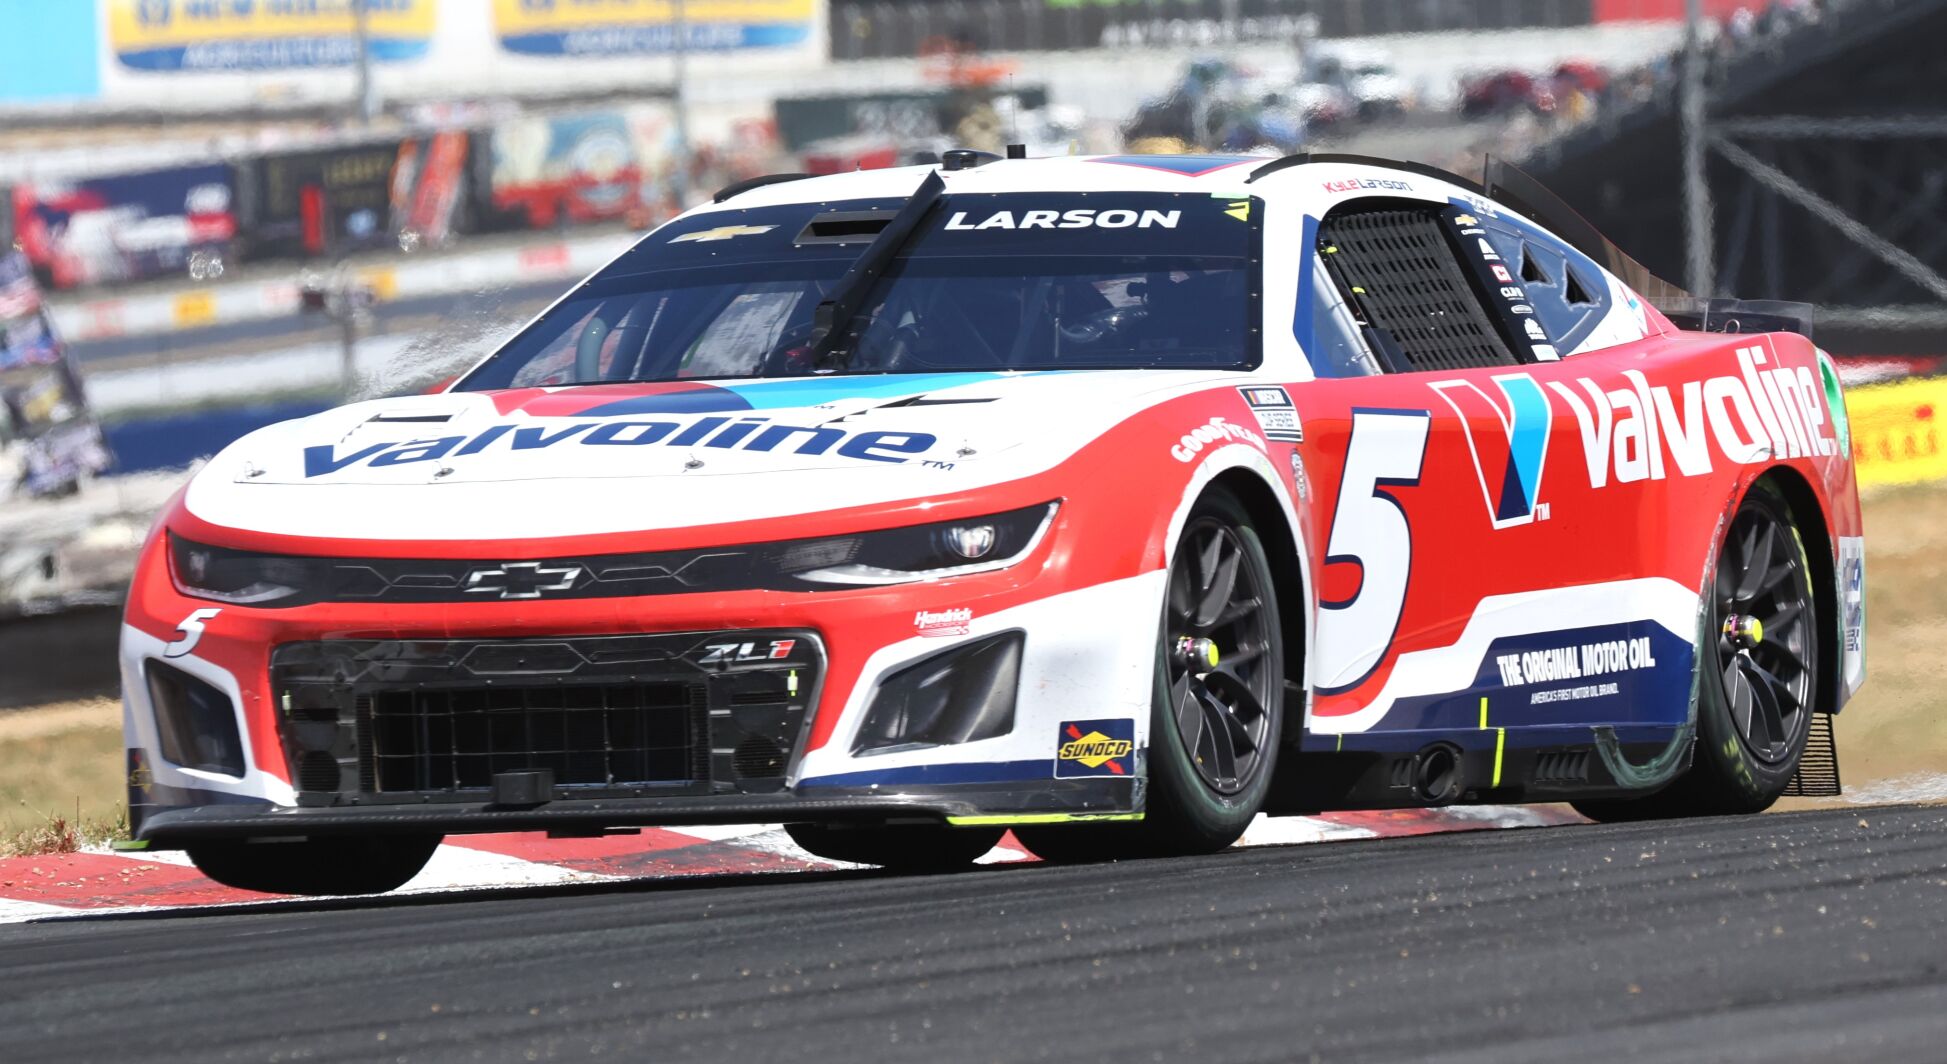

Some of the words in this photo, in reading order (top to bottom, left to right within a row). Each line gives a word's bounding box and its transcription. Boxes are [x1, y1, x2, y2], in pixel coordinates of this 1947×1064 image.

[943, 208, 1182, 231] LARSON
[1312, 406, 1432, 697] 5
[913, 607, 973, 629] Hendrick
[164, 607, 225, 657] 5
[698, 639, 796, 664] ZL1
[1496, 653, 1525, 687] THE
[1521, 645, 1582, 684] ORIGINAL
[1581, 640, 1629, 677] MOTOR
[1062, 741, 1128, 758] SUNOCO
